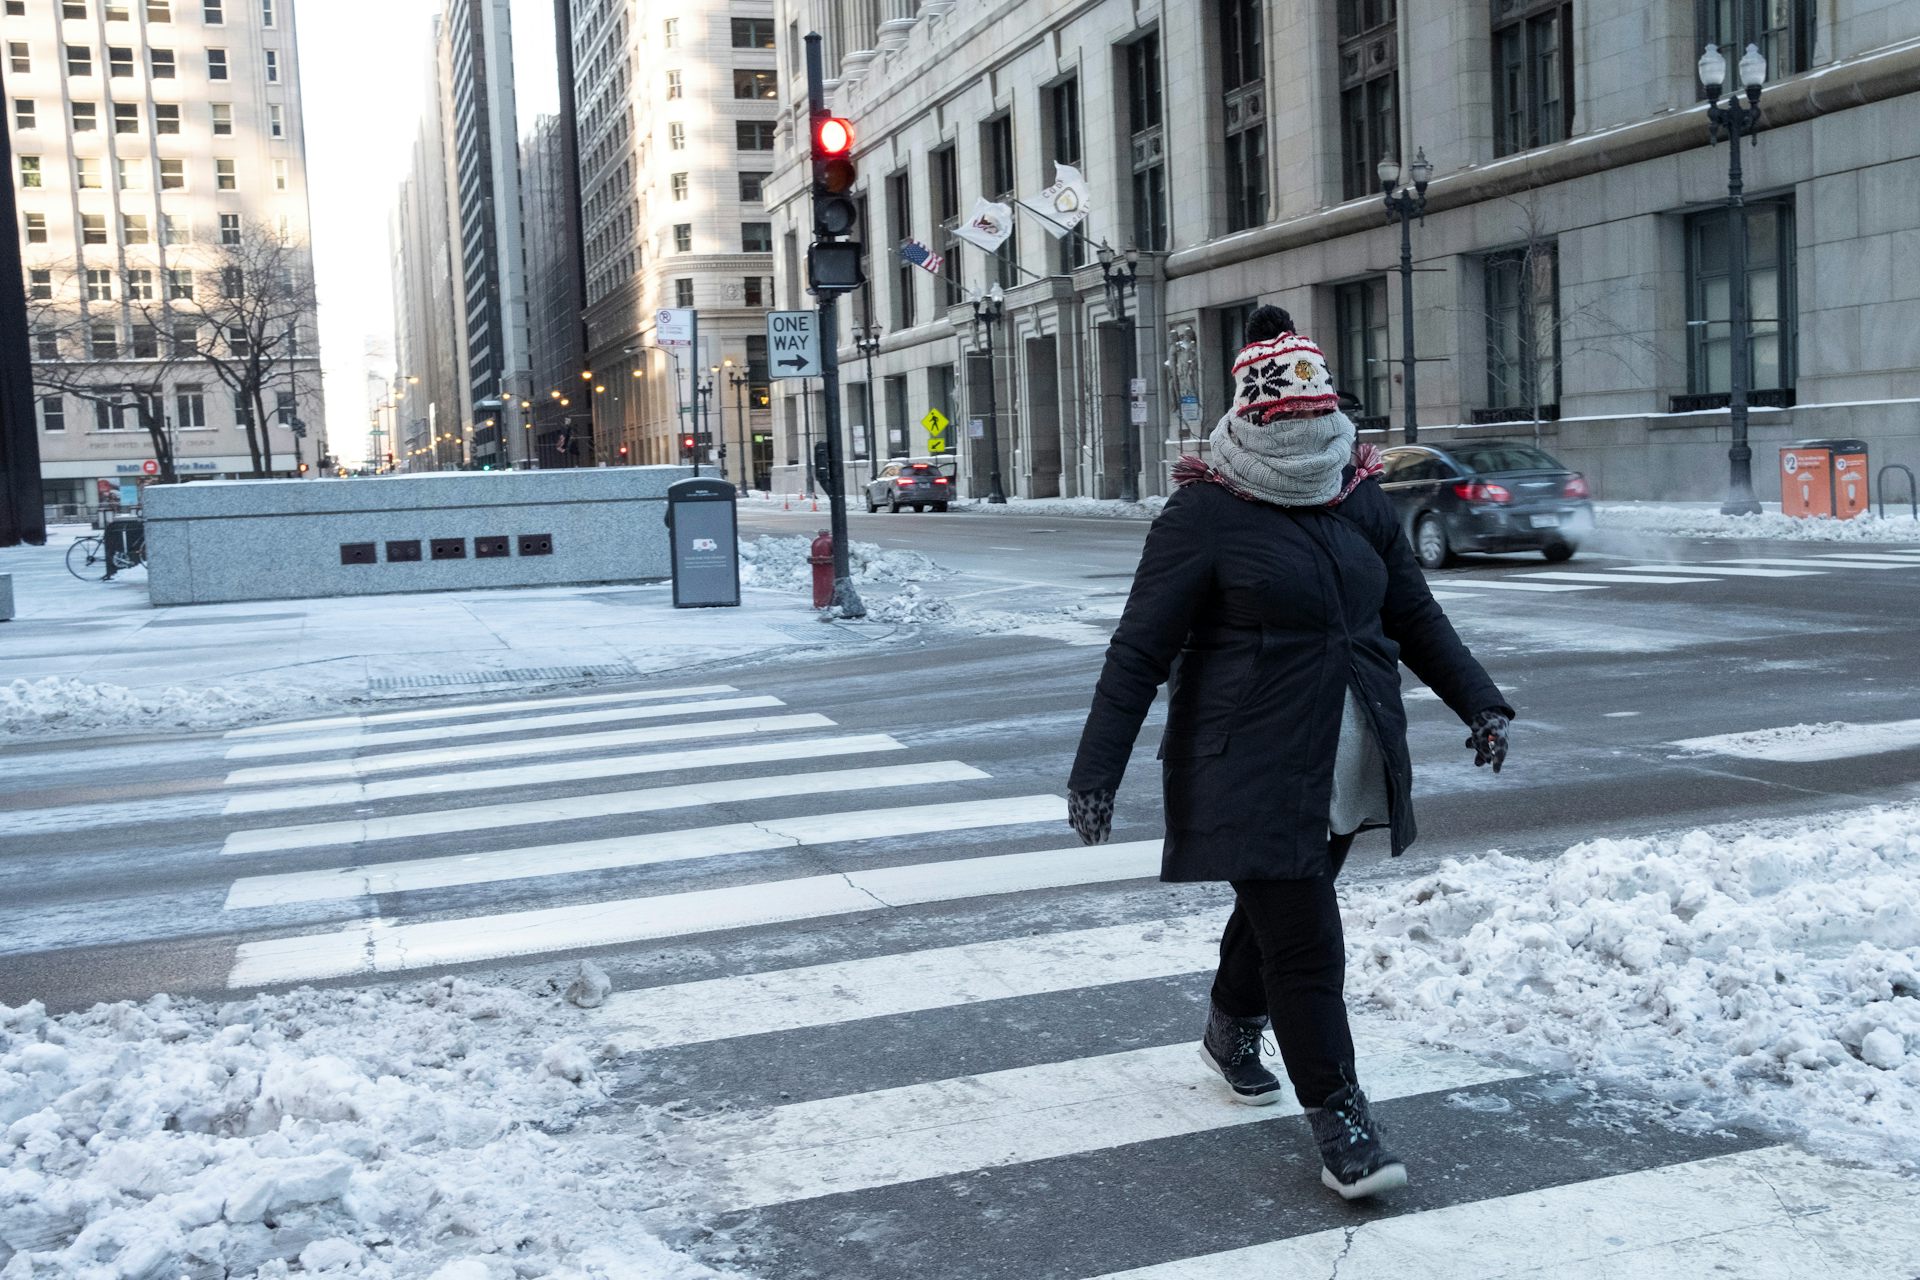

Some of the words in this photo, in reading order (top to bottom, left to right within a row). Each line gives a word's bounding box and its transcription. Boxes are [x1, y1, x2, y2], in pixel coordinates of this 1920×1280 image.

[773, 317, 809, 332] ONE
[774, 335, 809, 350] WAY
[192, 461, 216, 470] Bank
